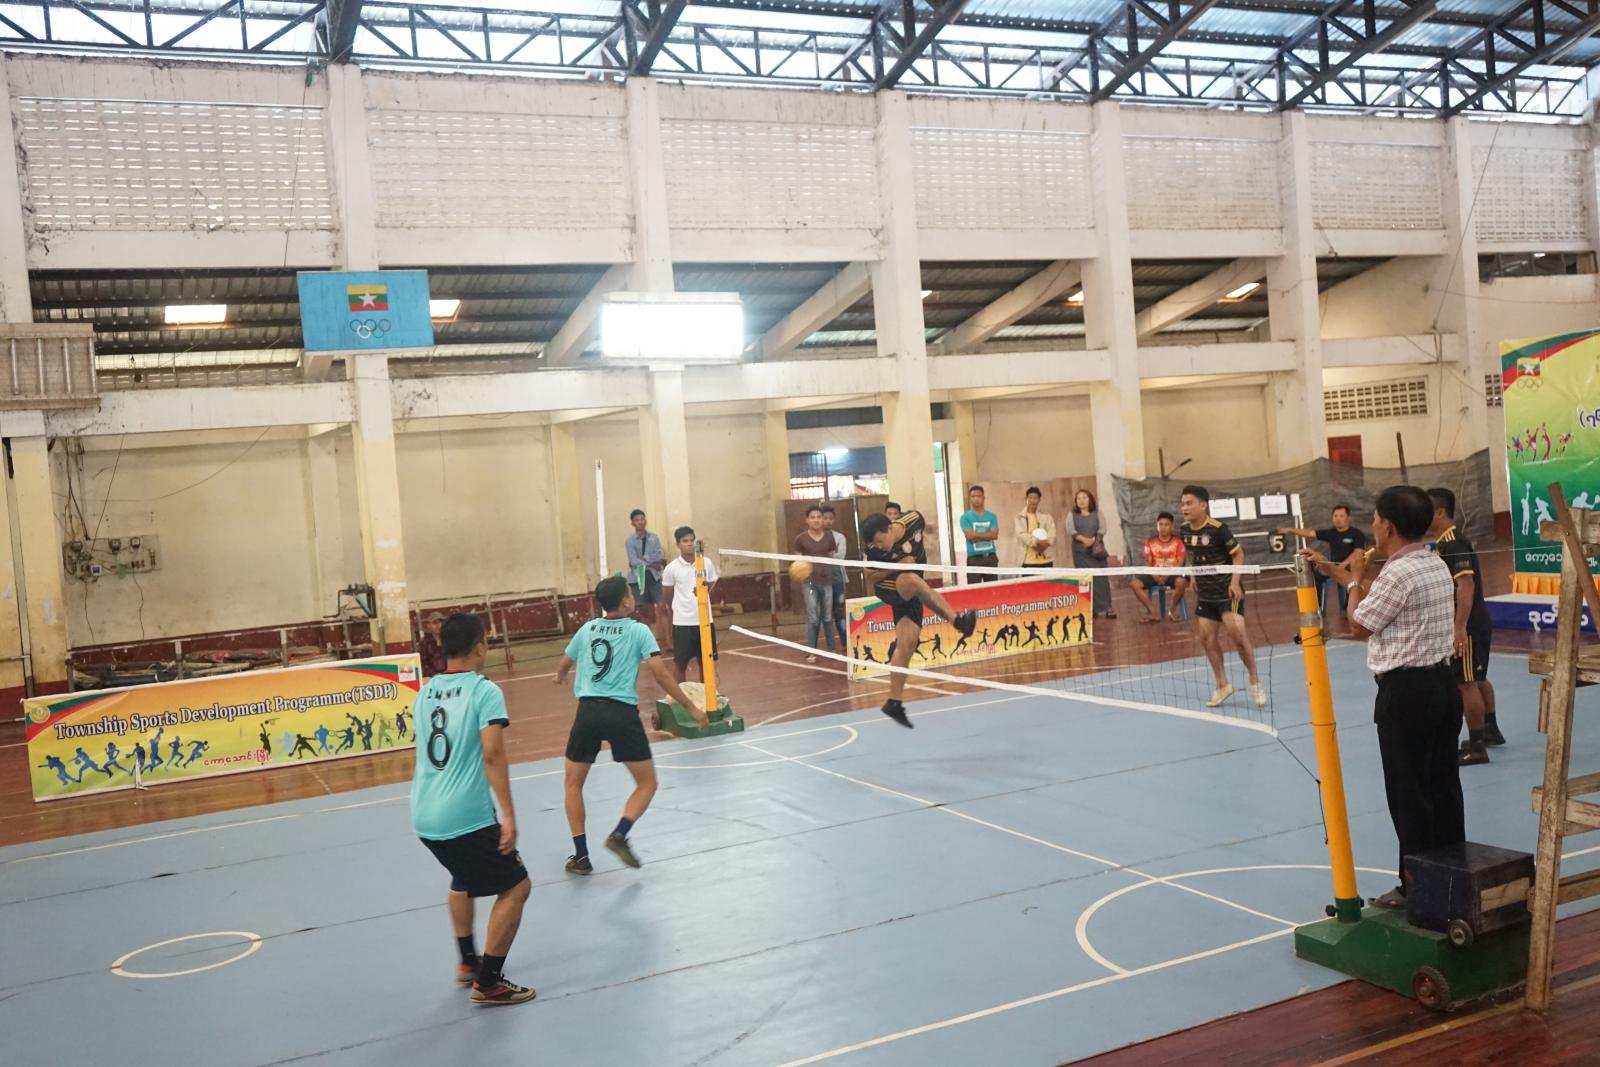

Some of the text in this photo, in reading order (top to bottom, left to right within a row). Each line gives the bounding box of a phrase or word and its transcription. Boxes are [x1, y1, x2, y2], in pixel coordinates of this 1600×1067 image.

[1272, 535, 1284, 552] 5
[590, 637, 614, 684] 9
[54, 682, 398, 739] Township Sports Development Programme(TSDP)
[427, 705, 452, 771] 8
